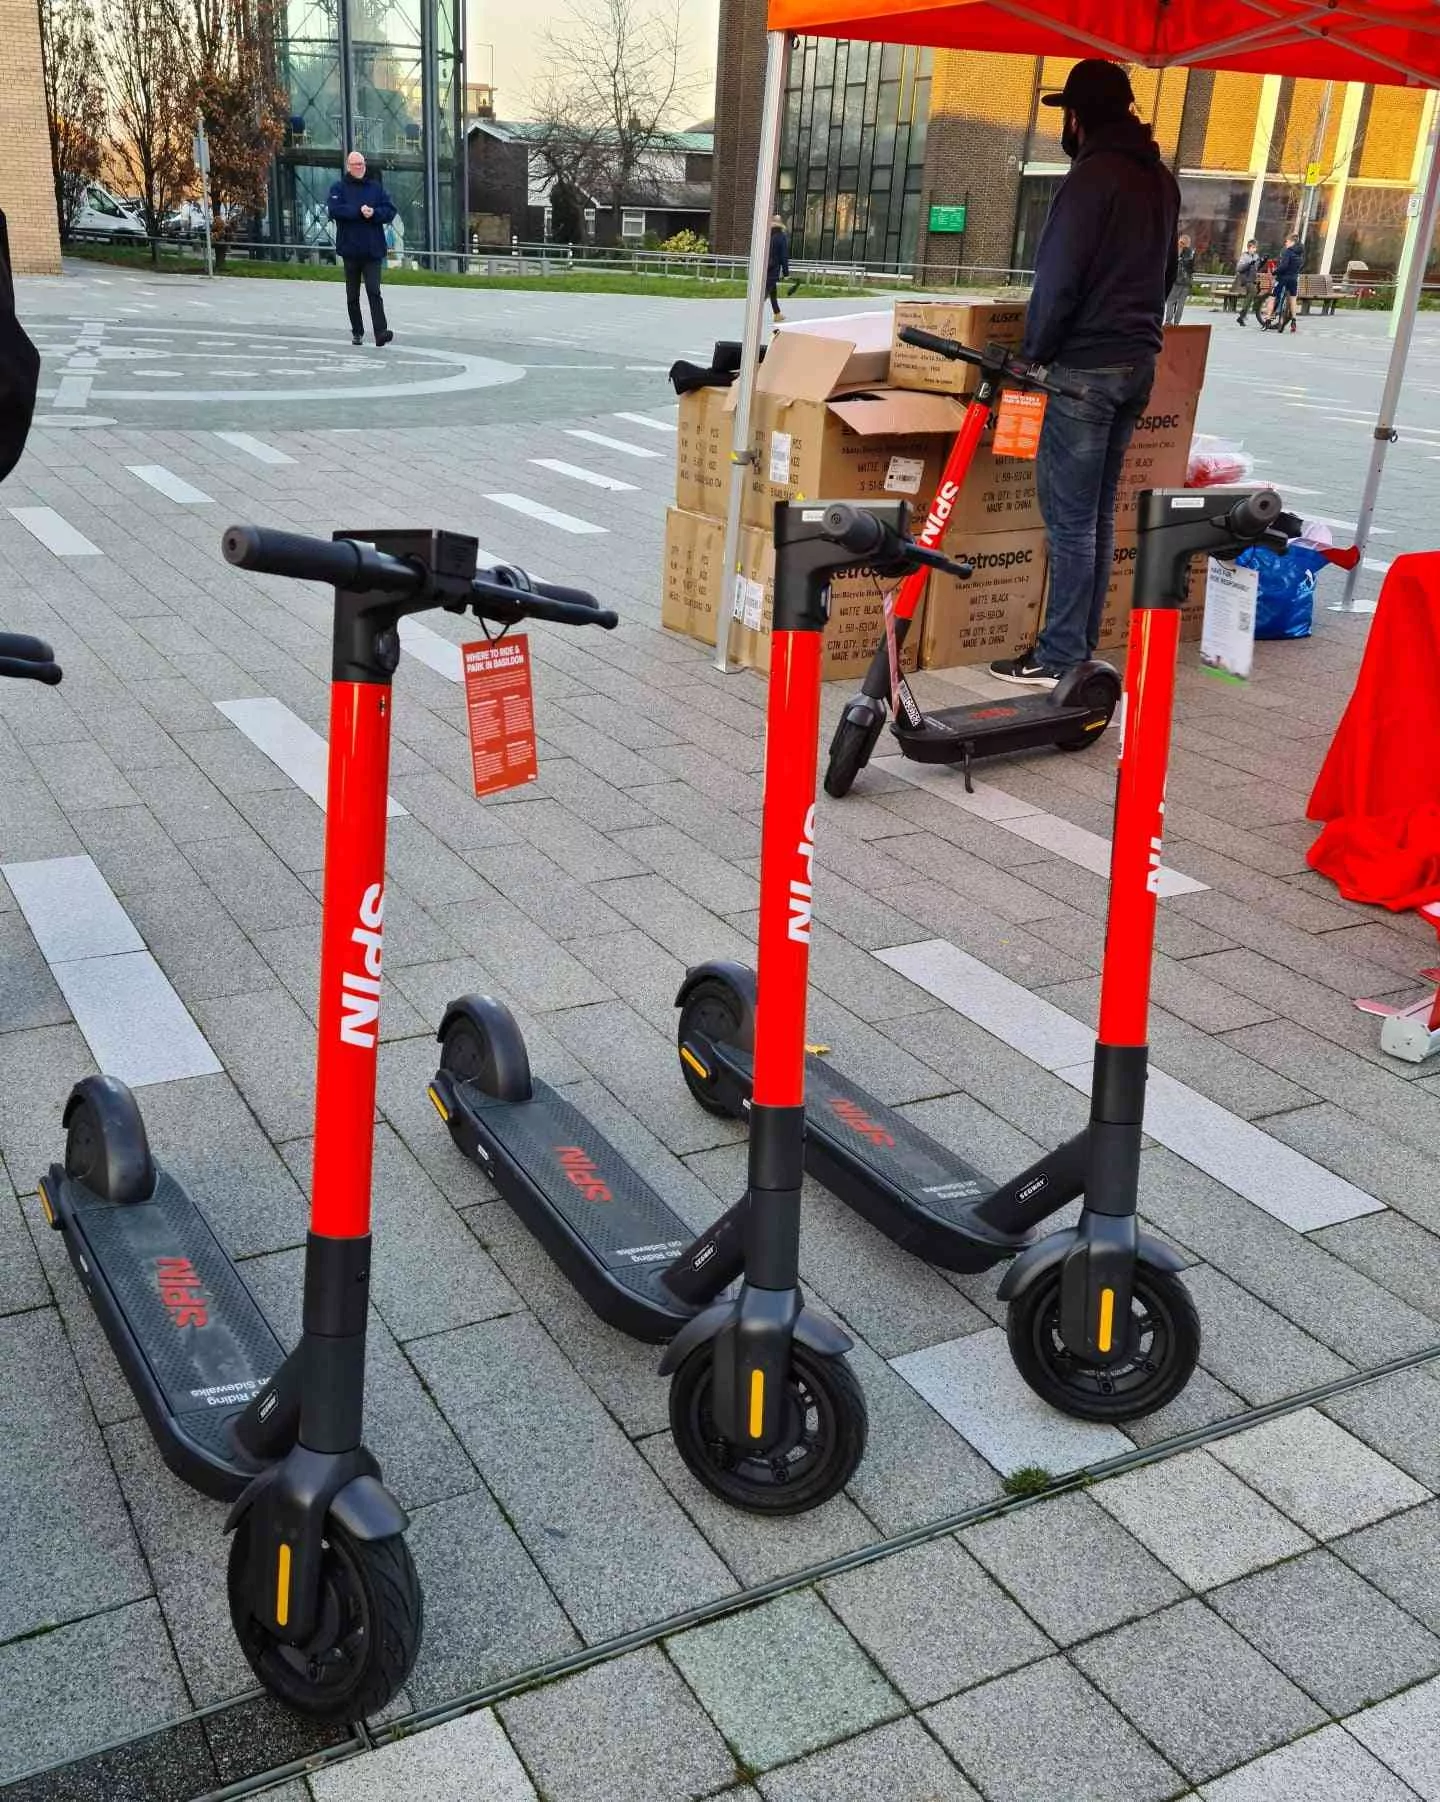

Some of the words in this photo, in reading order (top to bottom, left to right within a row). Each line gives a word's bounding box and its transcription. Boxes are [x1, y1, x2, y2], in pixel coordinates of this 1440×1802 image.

[1135, 413, 1180, 433] ospec
[921, 480, 960, 545] SPIN
[466, 650, 490, 662] WHERE
[490, 648, 499, 659] TO
[499, 646, 514, 657] RIDE
[467, 661, 485, 672] PARK
[485, 659, 493, 670] IN
[493, 654, 525, 669] BASILDON
[340, 883, 385, 1049] SPIN
[829, 1098, 896, 1148] SPIN
[554, 1145, 614, 1202] SPIN
[1018, 1177, 1046, 1201] SEGWAY
[157, 1257, 209, 1328] SPIN
[190, 1380, 256, 1398] Sidewalks
[207, 1391, 250, 1406] Riding
